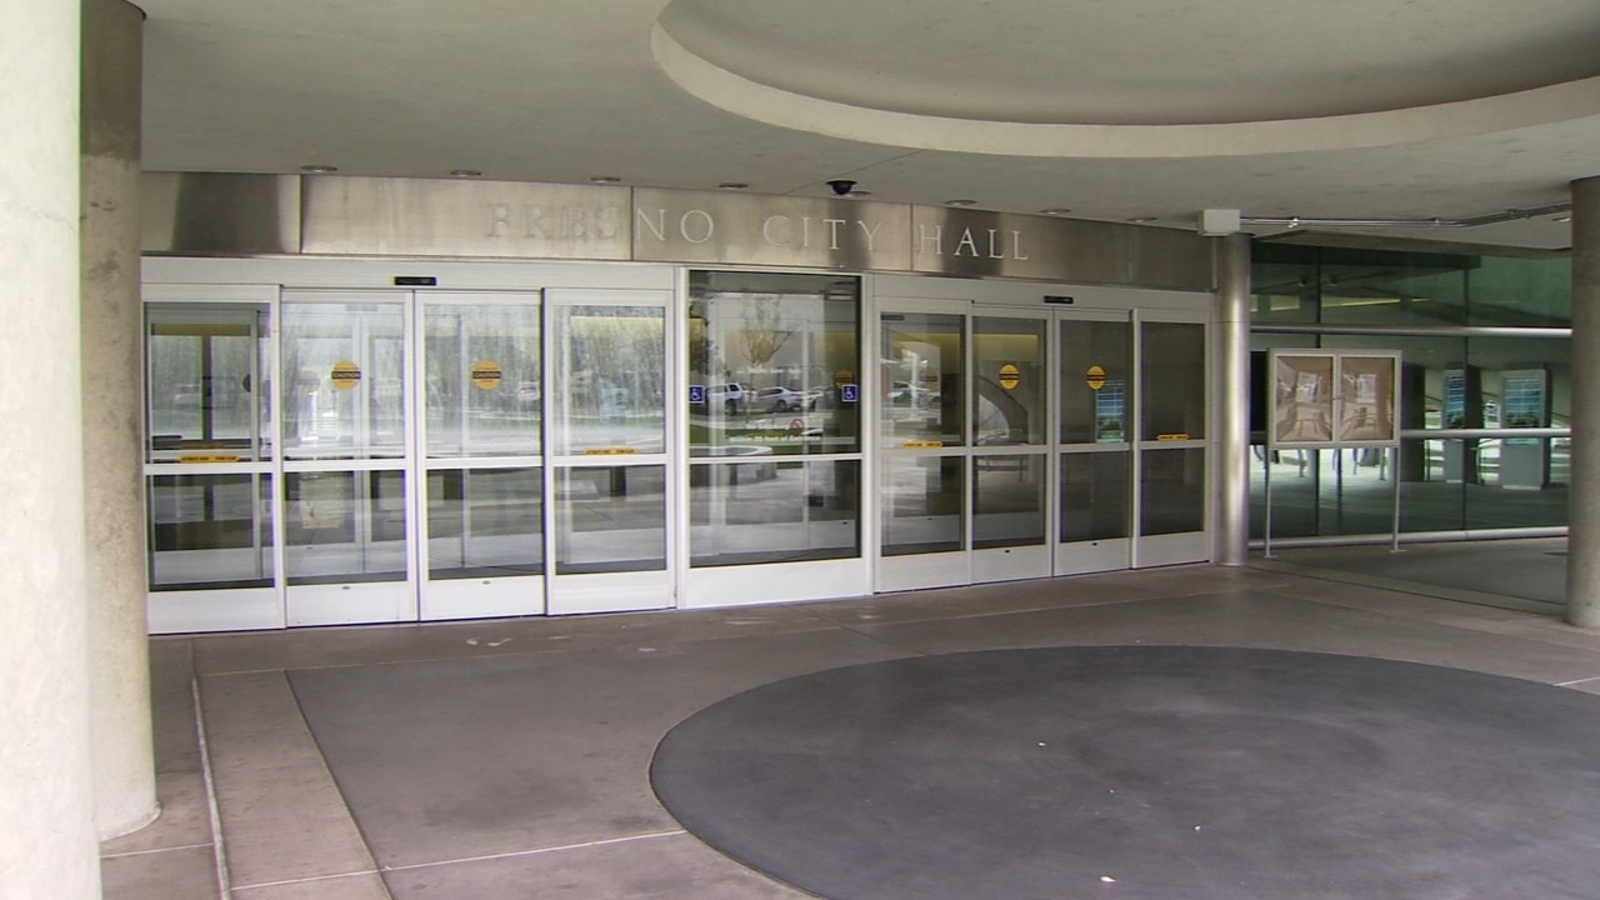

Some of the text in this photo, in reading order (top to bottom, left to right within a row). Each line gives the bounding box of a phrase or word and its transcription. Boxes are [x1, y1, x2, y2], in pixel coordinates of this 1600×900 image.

[486, 202, 1029, 261] FRESNO CITY HALL
